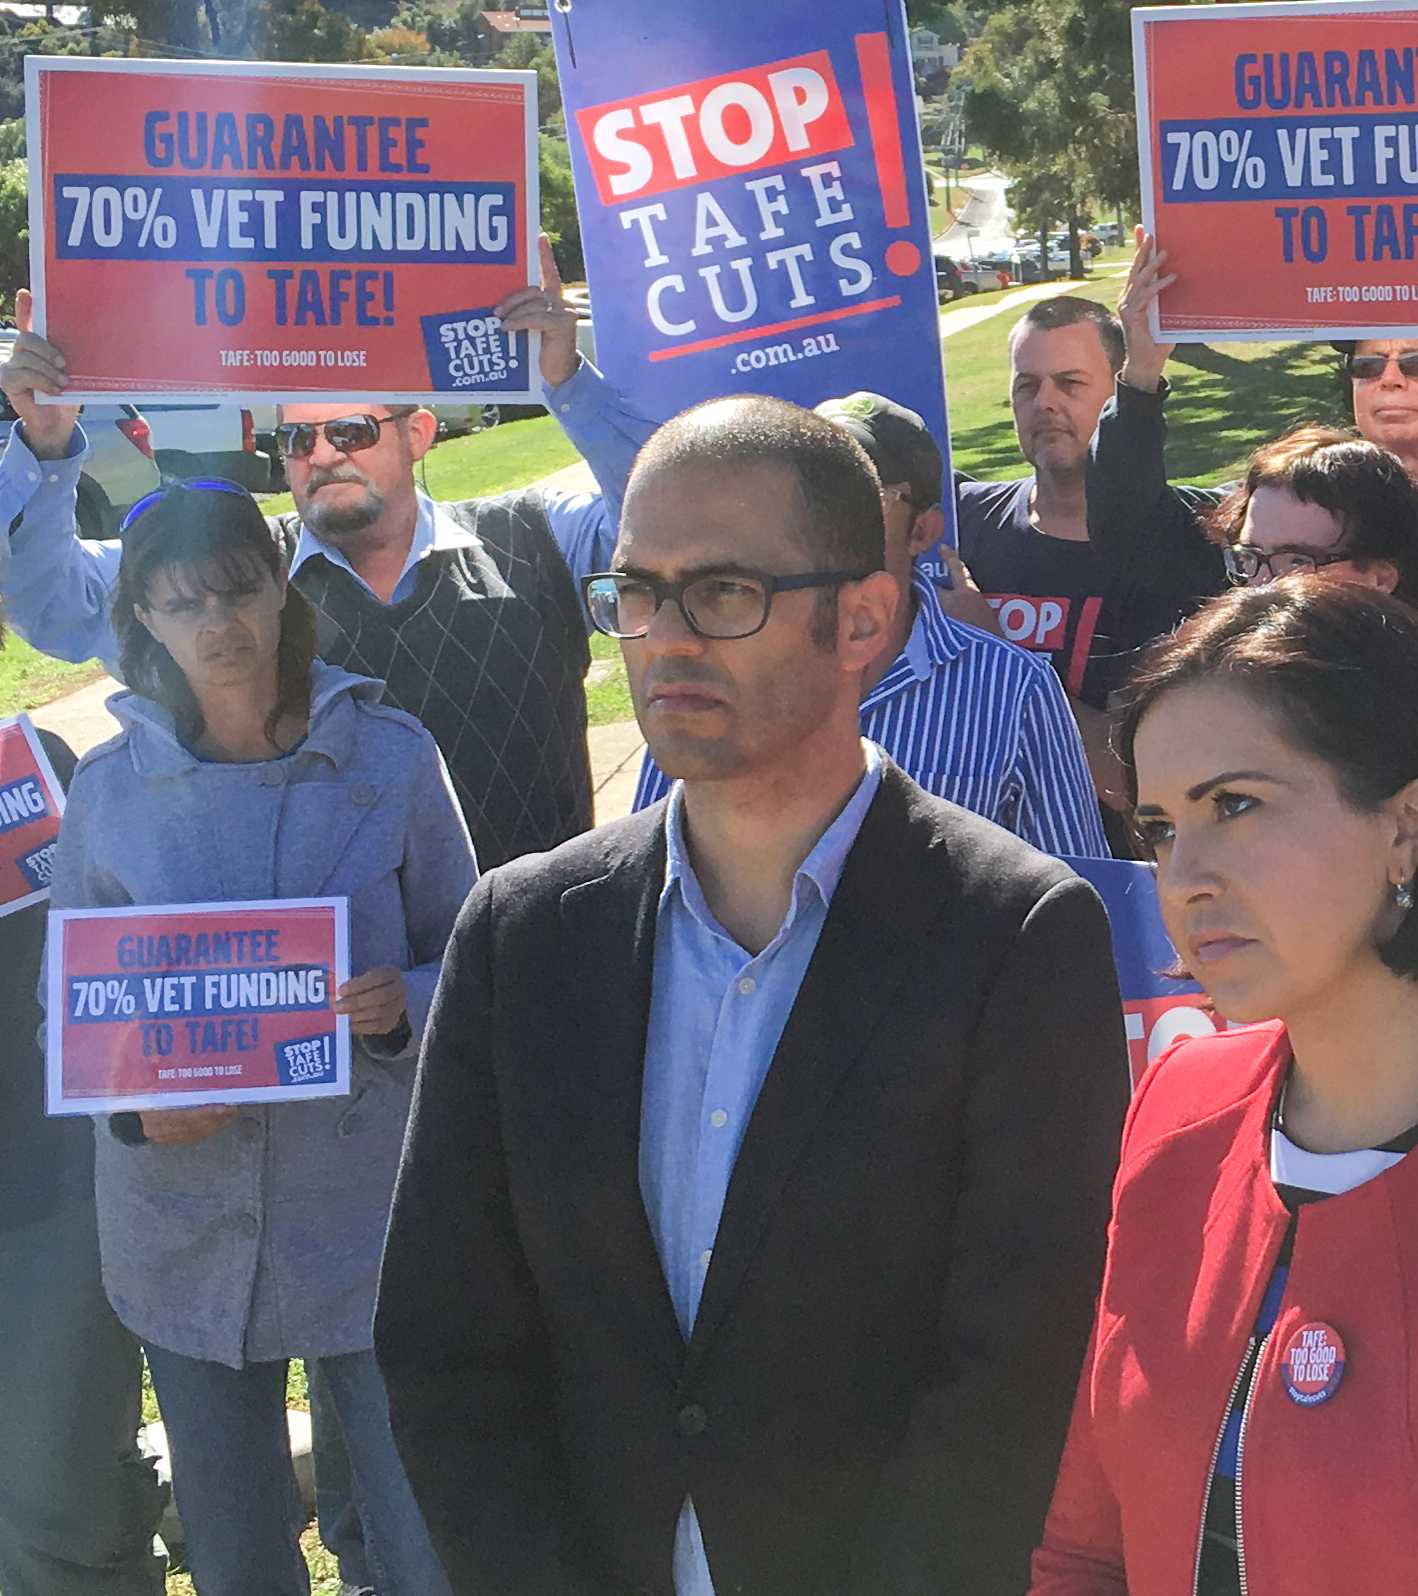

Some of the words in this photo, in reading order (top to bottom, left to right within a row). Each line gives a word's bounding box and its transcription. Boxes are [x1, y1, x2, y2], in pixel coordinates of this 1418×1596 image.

[144, 111, 430, 174] GUARANTEE
[593, 68, 828, 195] STOP
[1167, 130, 1265, 190] 70%
[1277, 127, 1359, 186] VET
[62, 186, 176, 249] 70%
[191, 189, 284, 249] VET
[300, 191, 507, 252] FUNDING
[619, 160, 855, 269] TAFE
[1275, 206, 1327, 263] TO
[186, 269, 245, 326] TO
[267, 269, 394, 327] TAFE!
[646, 231, 875, 336] CUTS
[1306, 286, 1336, 302] TAFE:
[1337, 286, 1360, 302] TOO
[1362, 286, 1392, 301] GOOD
[1394, 285, 1409, 301] TO
[440, 317, 501, 342] STOP
[444, 335, 502, 359] TAFE
[220, 350, 254, 366] TAFE:
[255, 351, 279, 366] TOO
[282, 351, 316, 366] GOOD
[319, 351, 335, 366] TO
[338, 351, 367, 366] LOSE
[448, 353, 506, 377] CUTS
[731, 334, 839, 374] .com.au
[452, 370, 507, 387] .com.au
[0, 781, 45, 827] ING
[118, 929, 280, 969] GUARANTEE
[73, 980, 135, 1016] 70%
[143, 976, 196, 1013] VET
[205, 969, 325, 1009] FUNDING
[140, 1022, 173, 1056] TO
[186, 1018, 259, 1054] TAFE!
[284, 1040, 321, 1057] STOP
[288, 1051, 320, 1067] TAFE
[1290, 1348, 1308, 1364] TOO
[1309, 1346, 1336, 1363] GOOD
[1302, 1330, 1328, 1346] TAFE:
[1293, 1365, 1305, 1381] TO
[1306, 1364, 1329, 1381] LOSE
